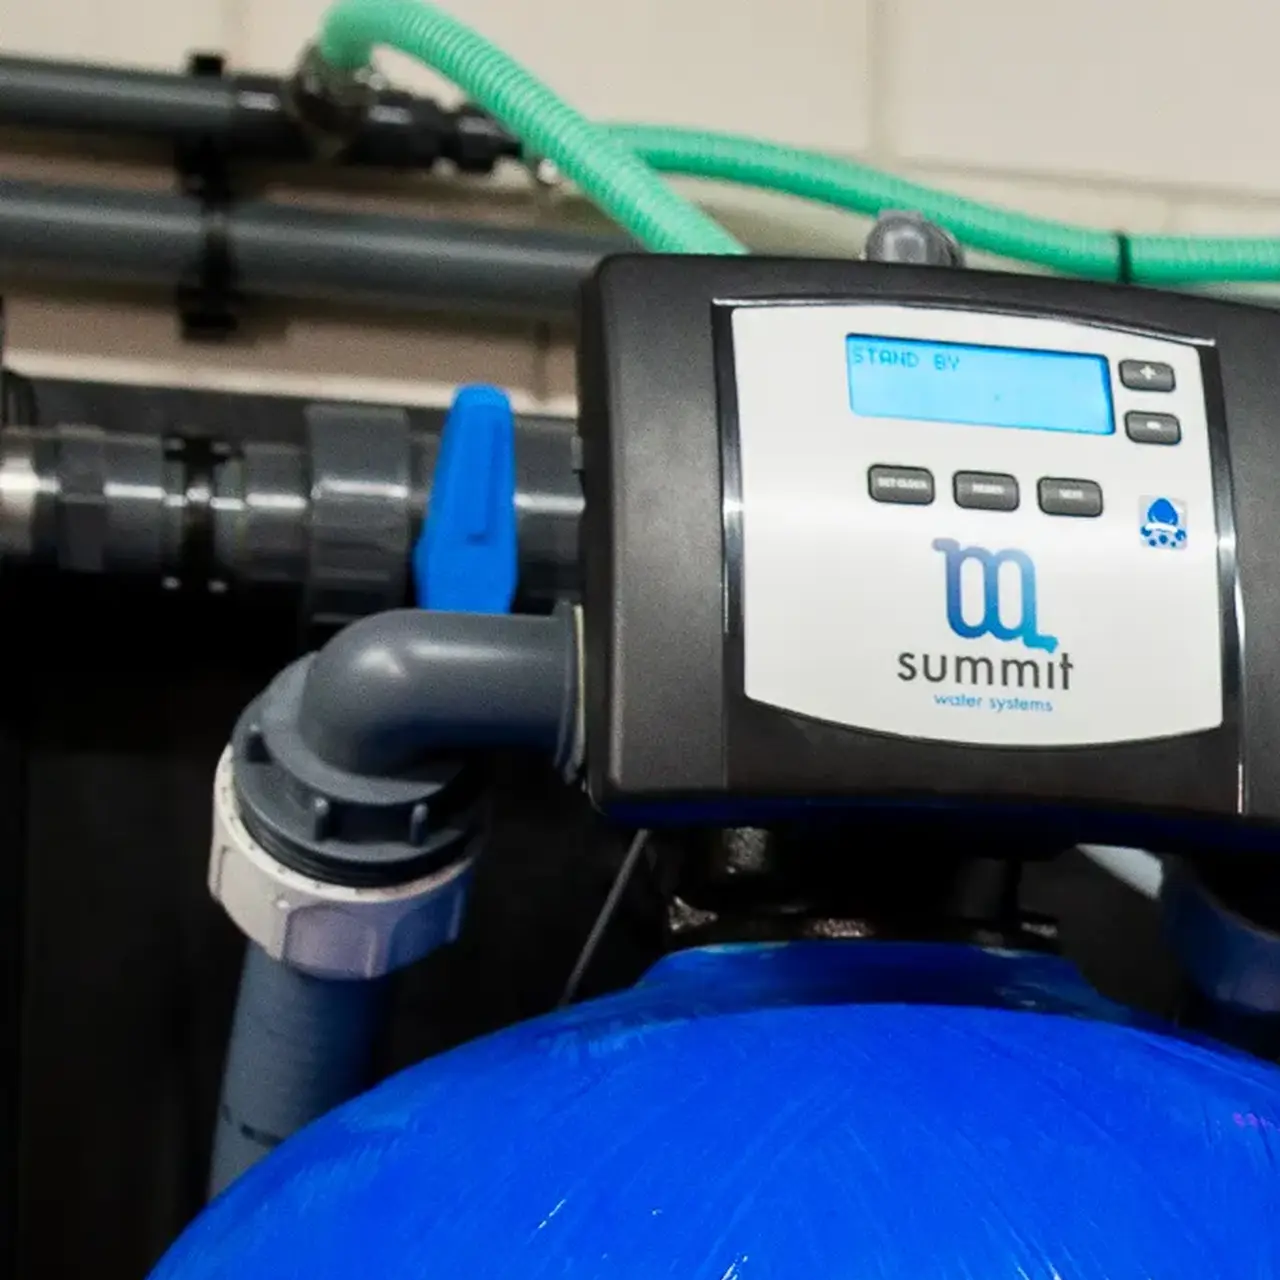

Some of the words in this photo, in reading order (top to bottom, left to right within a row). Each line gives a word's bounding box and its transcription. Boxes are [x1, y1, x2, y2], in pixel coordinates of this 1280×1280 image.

[853, 346, 919, 368] STAND
[935, 354, 960, 371] BY
[897, 652, 1074, 690] summit
[934, 693, 982, 708] water
[990, 696, 1053, 713] systems
